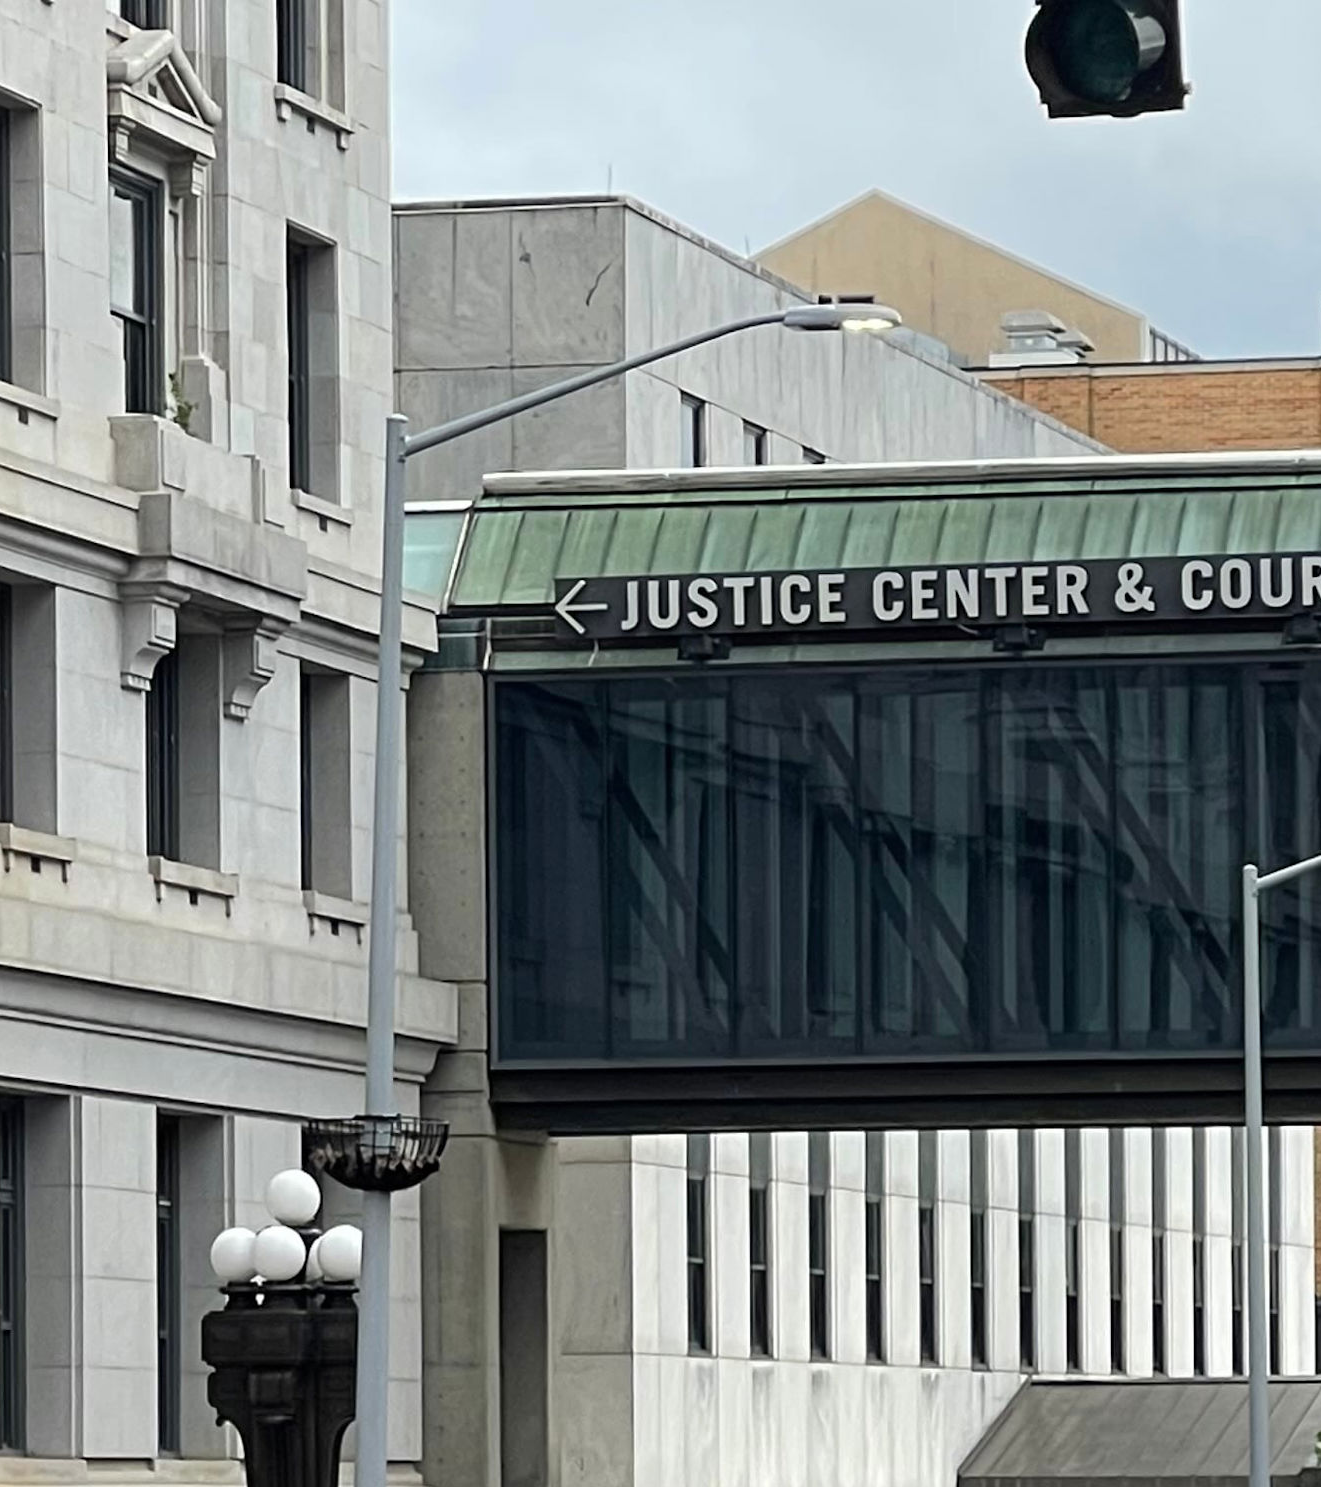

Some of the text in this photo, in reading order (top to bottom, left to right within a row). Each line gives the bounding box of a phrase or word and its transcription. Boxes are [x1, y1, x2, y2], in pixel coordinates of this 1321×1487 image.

[620, 573, 847, 630] JUSTICE
[872, 562, 1089, 622] CENTER
[1114, 564, 1156, 613] &
